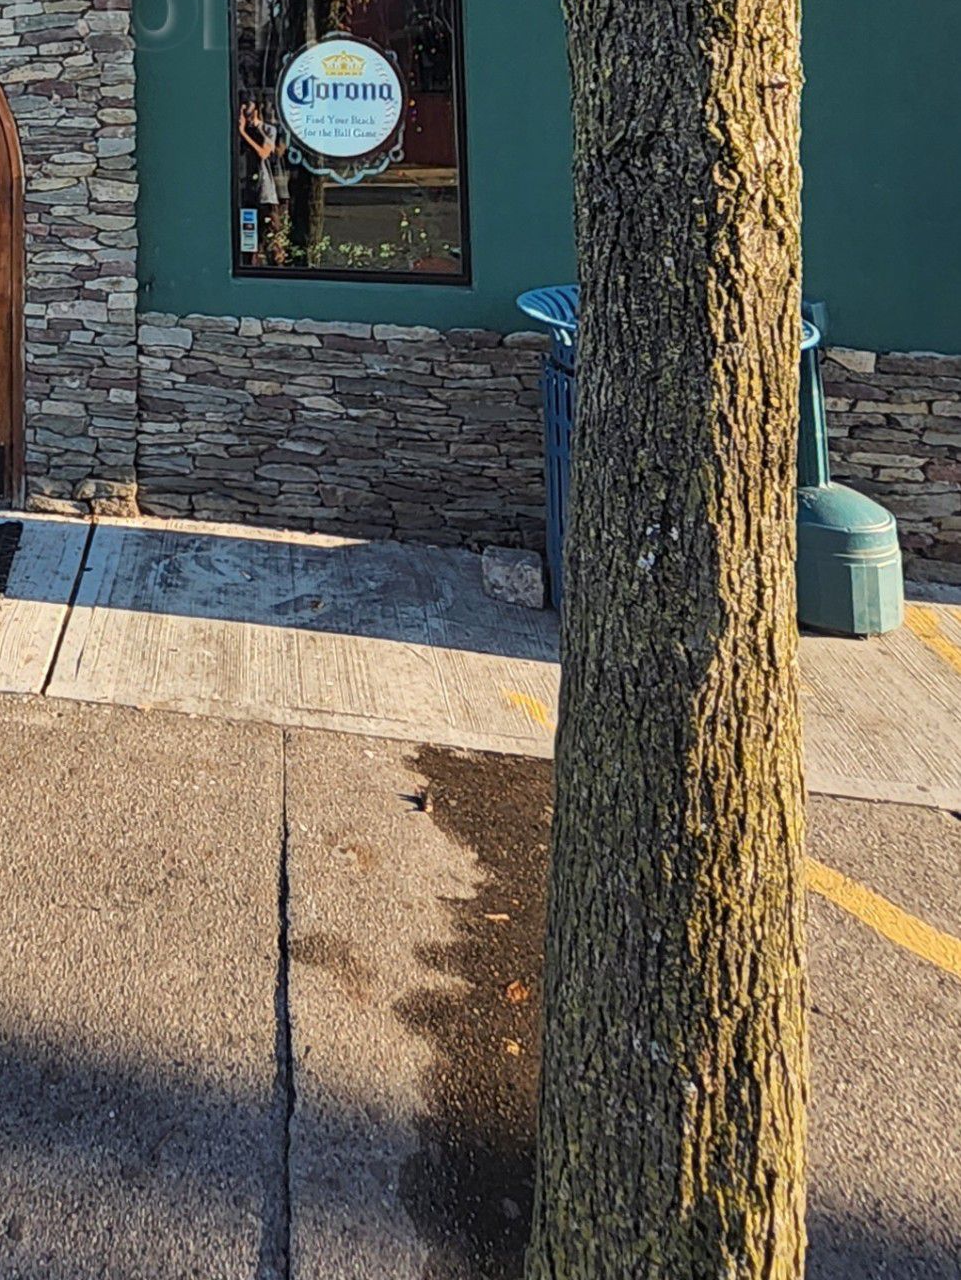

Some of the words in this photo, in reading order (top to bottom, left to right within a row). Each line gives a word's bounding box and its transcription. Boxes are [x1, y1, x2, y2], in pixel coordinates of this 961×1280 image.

[287, 74, 394, 108] Corona
[306, 115, 325, 125] Find
[327, 115, 350, 125] Your
[351, 115, 375, 125] Beach
[303, 128, 316, 138] for
[318, 128, 332, 138] the
[334, 128, 351, 138] Ball
[353, 128, 377, 138] Game
